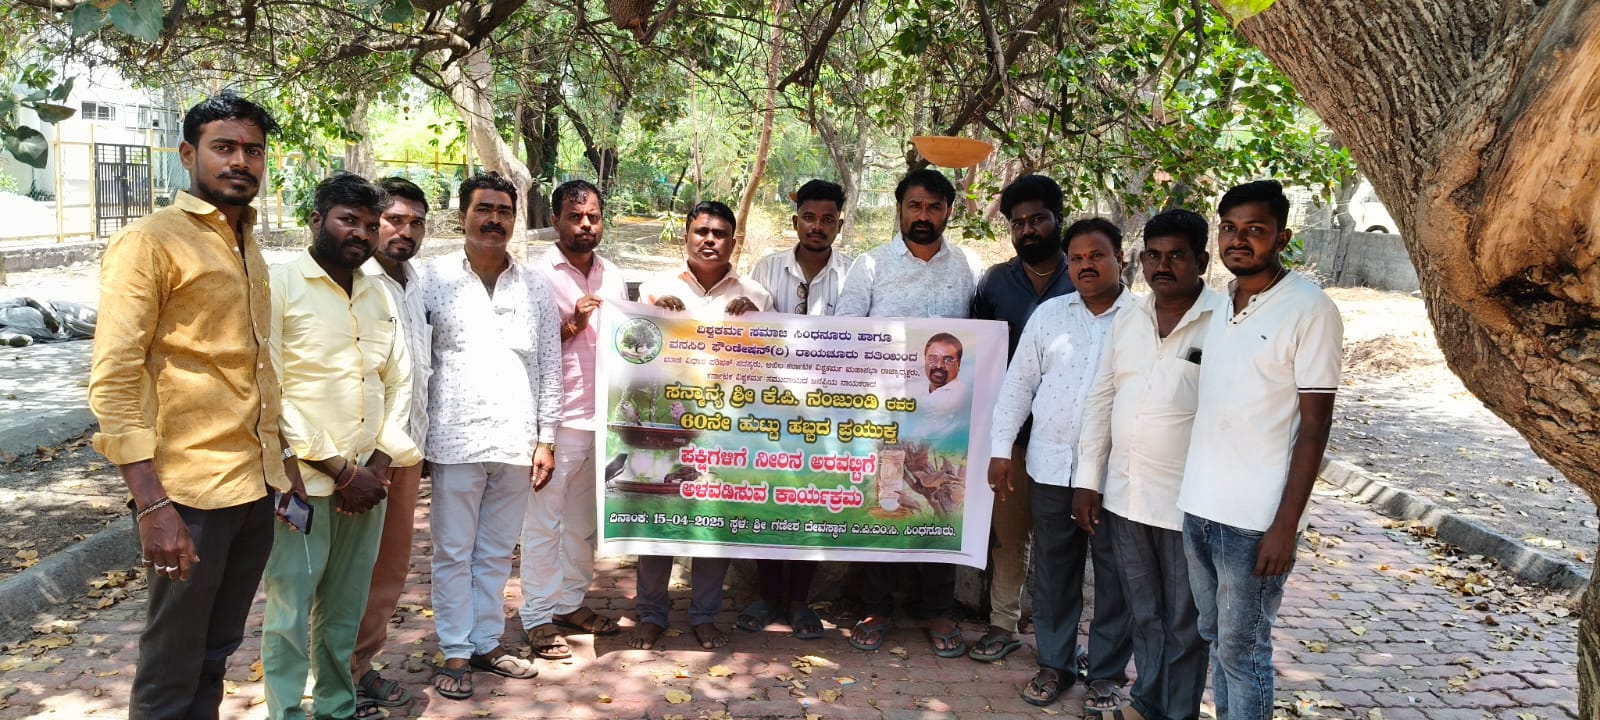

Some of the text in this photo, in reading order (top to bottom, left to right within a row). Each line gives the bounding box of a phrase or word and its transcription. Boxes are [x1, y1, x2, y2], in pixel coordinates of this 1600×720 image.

[697, 325, 892, 342] ವಿಶ್ವಕರ್ಮ ಸಮಾಜ ಸಿಂಧನೂರು ಹಾಗೂ
[669, 340, 706, 350] ವನಸಿರಿ
[796, 349, 858, 360] ರಾಯಚೂರು
[864, 352, 918, 362] ವತಿಯಿಂದ
[665, 382, 916, 411] ಸನ್ಮಾನ್ಯ ಶ್ರೀ ಕೆ.ಪಿ. ನಂಜುಂಡಿ ರವರ
[680, 412, 898, 445] 60ನೇ ಹುಟ್ಟು ಹಬ್ಬದ ಪ್ರಯುಕ್ತ
[681, 446, 876, 482] ಪಕ್ಷಿಗಳಿಗೆ ನೀರಿನ ಅರವಟ್ಟಿಗೆ
[681, 481, 863, 511] ಅಳವಡಿಸುವ ಕಾರ್ಯಕ್ರಮ
[609, 511, 648, 524] ದಿನಾಂಕ:
[653, 514, 724, 527] 15-04-2025
[729, 518, 748, 533] ಸ್ಥಳ:
[753, 519, 766, 533] ಶ್ರೀ
[771, 519, 800, 531] ಗಣೇಶ
[804, 521, 847, 538] ದೇವಸ್ಥಾನ
